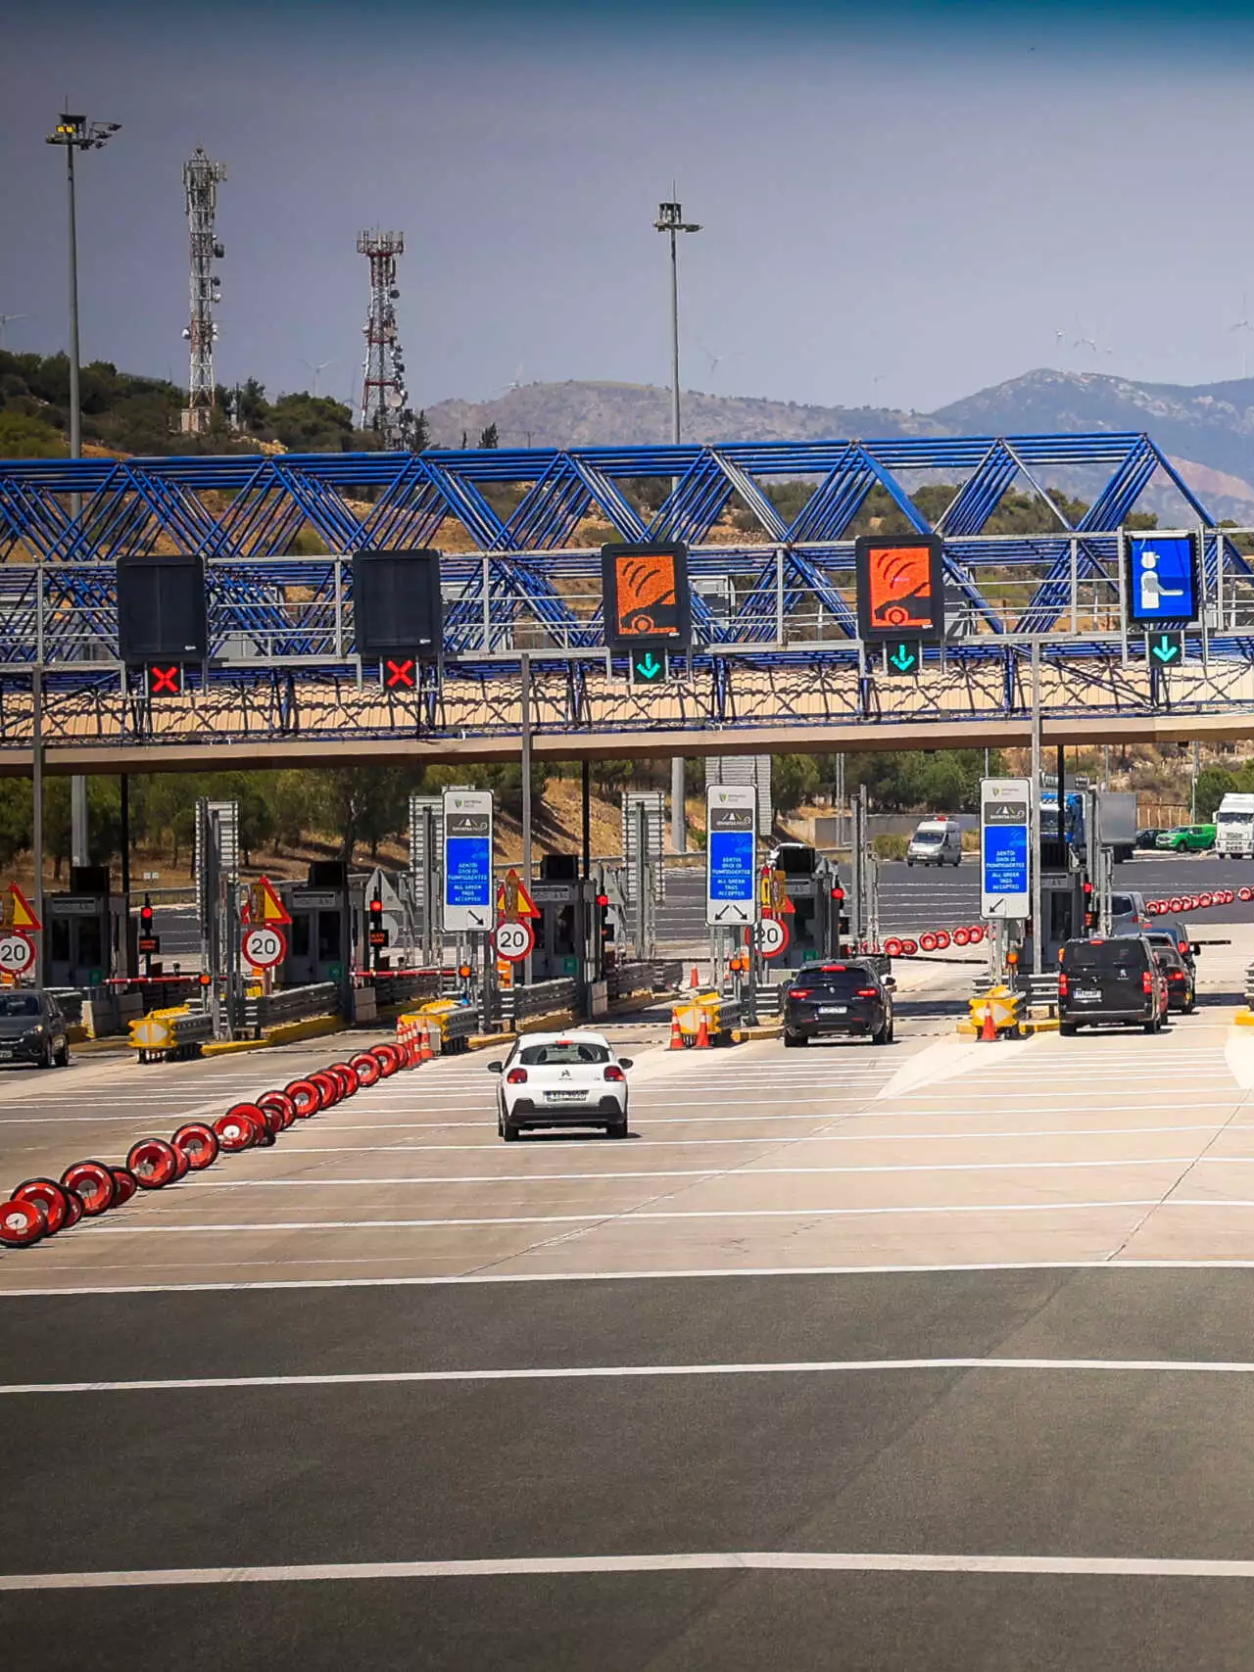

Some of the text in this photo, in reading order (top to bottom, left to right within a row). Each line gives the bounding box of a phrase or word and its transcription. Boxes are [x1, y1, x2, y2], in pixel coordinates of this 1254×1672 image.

[251, 937, 276, 955] 20
[500, 931, 525, 948] 20
[1, 944, 26, 962] 20
